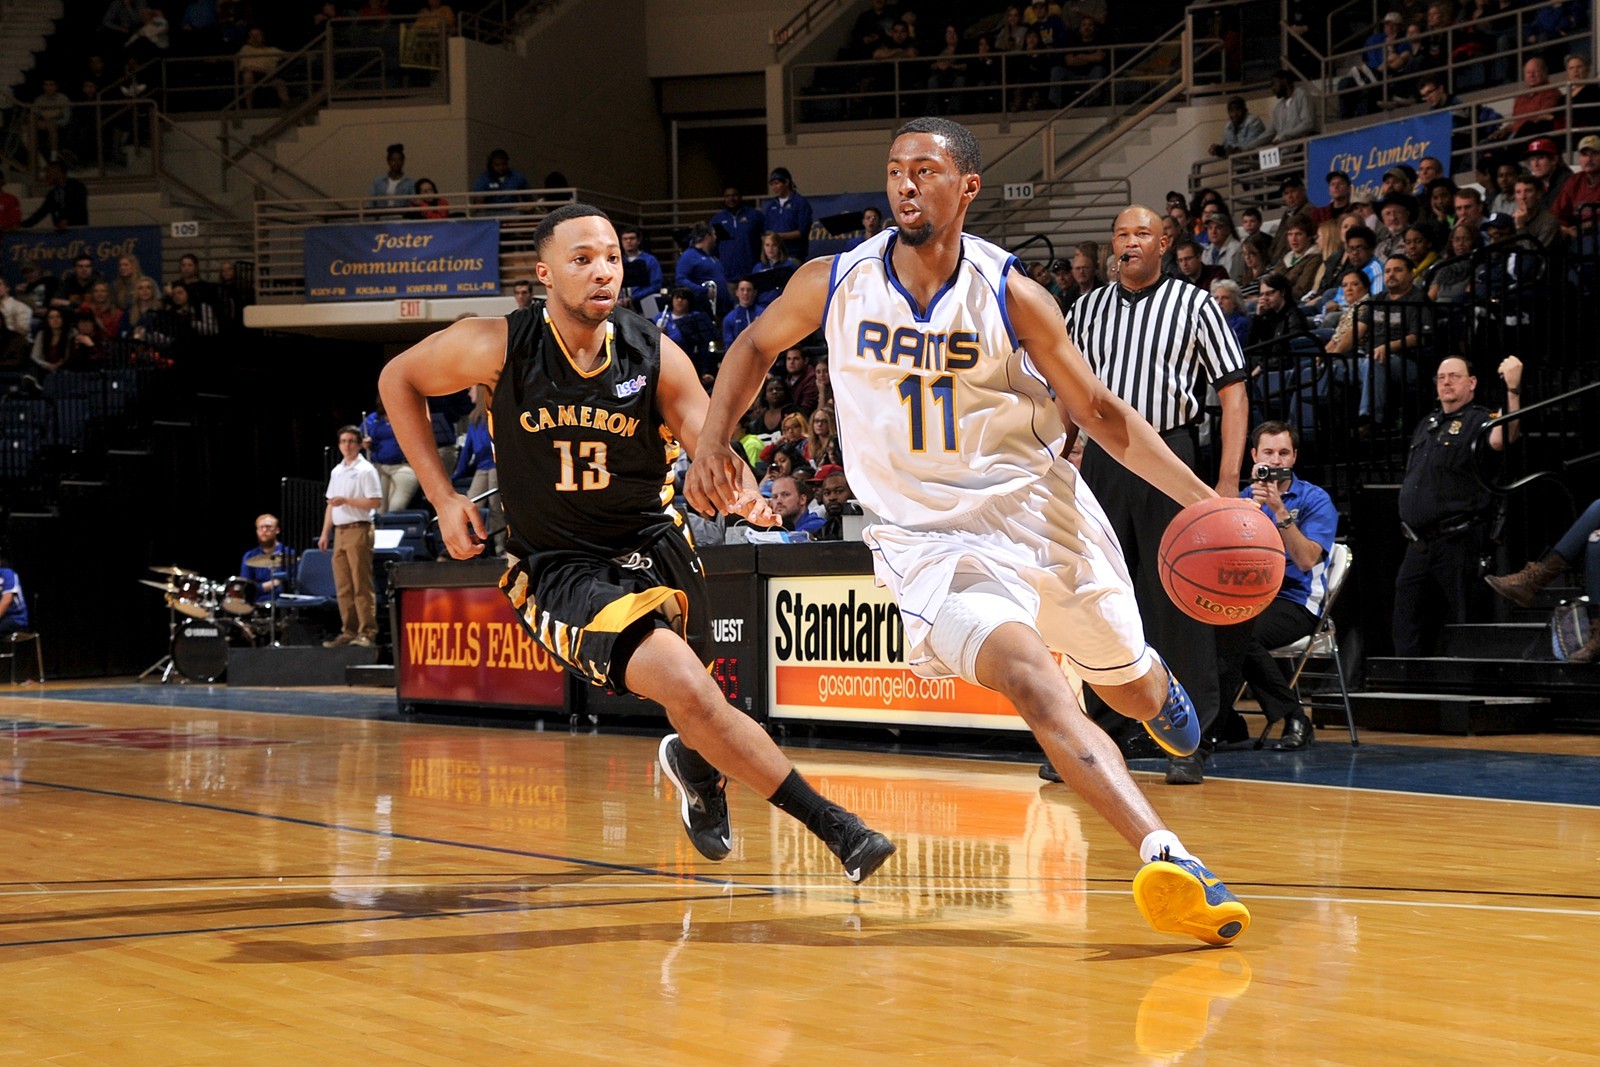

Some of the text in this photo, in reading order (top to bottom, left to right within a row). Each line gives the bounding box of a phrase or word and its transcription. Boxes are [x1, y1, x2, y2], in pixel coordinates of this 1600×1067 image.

[1263, 152, 1277, 166] 111
[1330, 136, 1431, 180] City Lumber
[1008, 186, 1031, 197] 110
[174, 224, 195, 235] 109
[97, 238, 138, 261] Golf
[372, 233, 433, 253] Foster
[330, 256, 484, 276] Communications
[456, 282, 495, 291] KCLL-FM
[401, 301, 420, 317] EXIT
[856, 320, 981, 372] RAMS
[520, 405, 641, 437] CAMERON
[896, 372, 960, 453] 11
[553, 440, 611, 491] 13
[1218, 567, 1272, 585] NCAA
[711, 619, 744, 642] UEST
[406, 622, 481, 668] WELLS
[818, 672, 955, 705] gosanangelo.com
